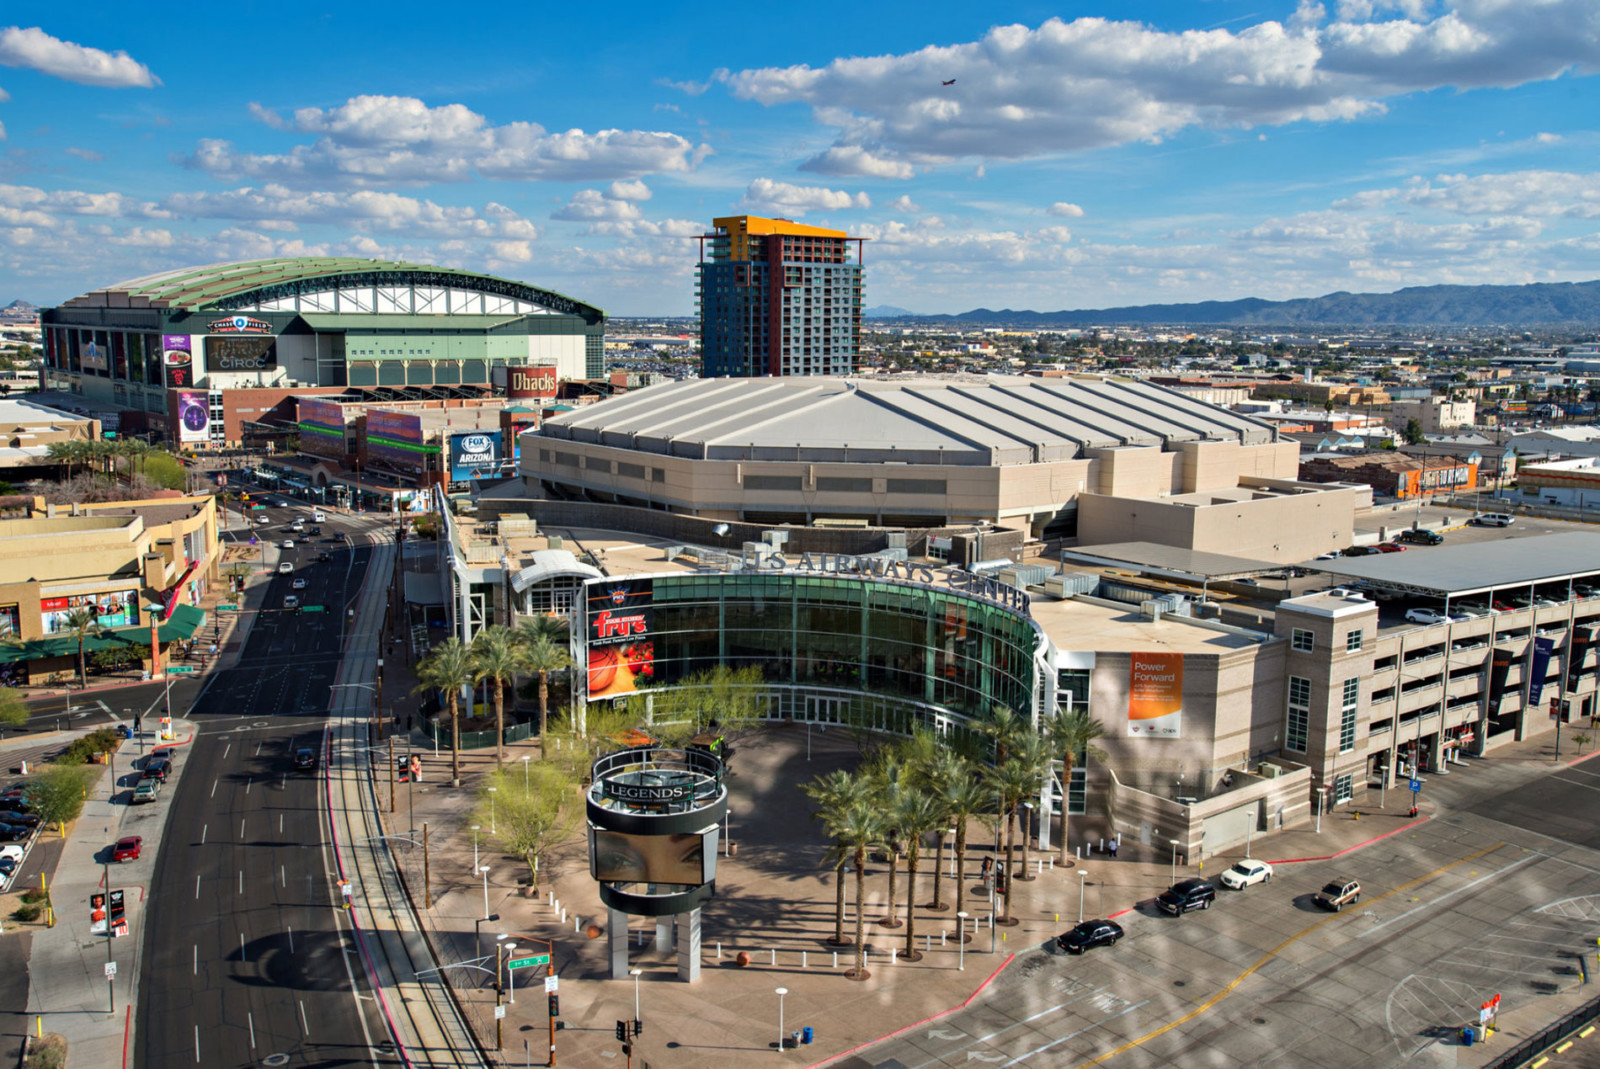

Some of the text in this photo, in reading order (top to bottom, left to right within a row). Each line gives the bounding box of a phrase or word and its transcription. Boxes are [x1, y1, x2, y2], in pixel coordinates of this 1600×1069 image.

[468, 437, 485, 445] FOX
[796, 551, 934, 583] AIRWAYS
[947, 569, 1032, 618] CENTER
[592, 610, 646, 638] fry's
[1134, 662, 1166, 671] Power
[1134, 672, 1175, 682] Forward
[611, 784, 683, 799] LEGENDS
